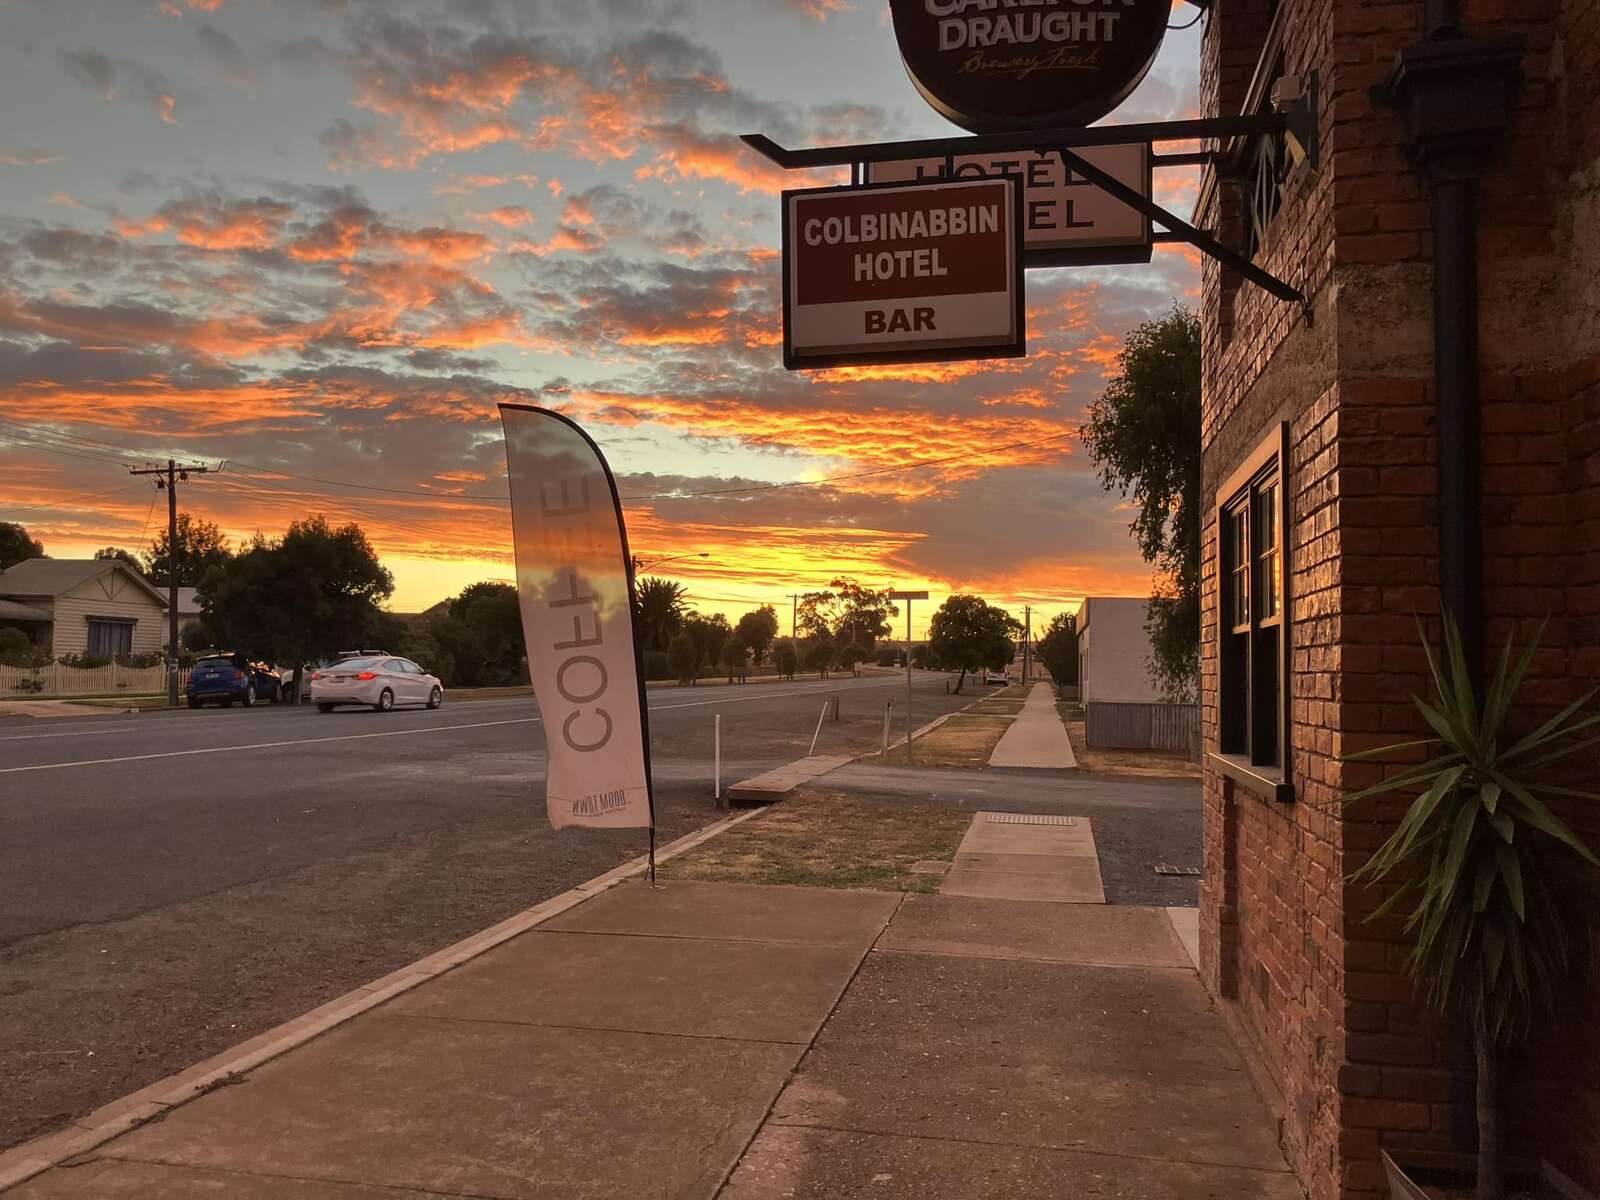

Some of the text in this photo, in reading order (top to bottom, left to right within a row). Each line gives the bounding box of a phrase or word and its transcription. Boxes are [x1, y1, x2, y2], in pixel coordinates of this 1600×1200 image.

[938, 12, 1121, 51] DRAUGHT
[804, 204, 998, 247] COLBINABBIN
[854, 248, 948, 282] HOTEL
[864, 306, 937, 335] BAR
